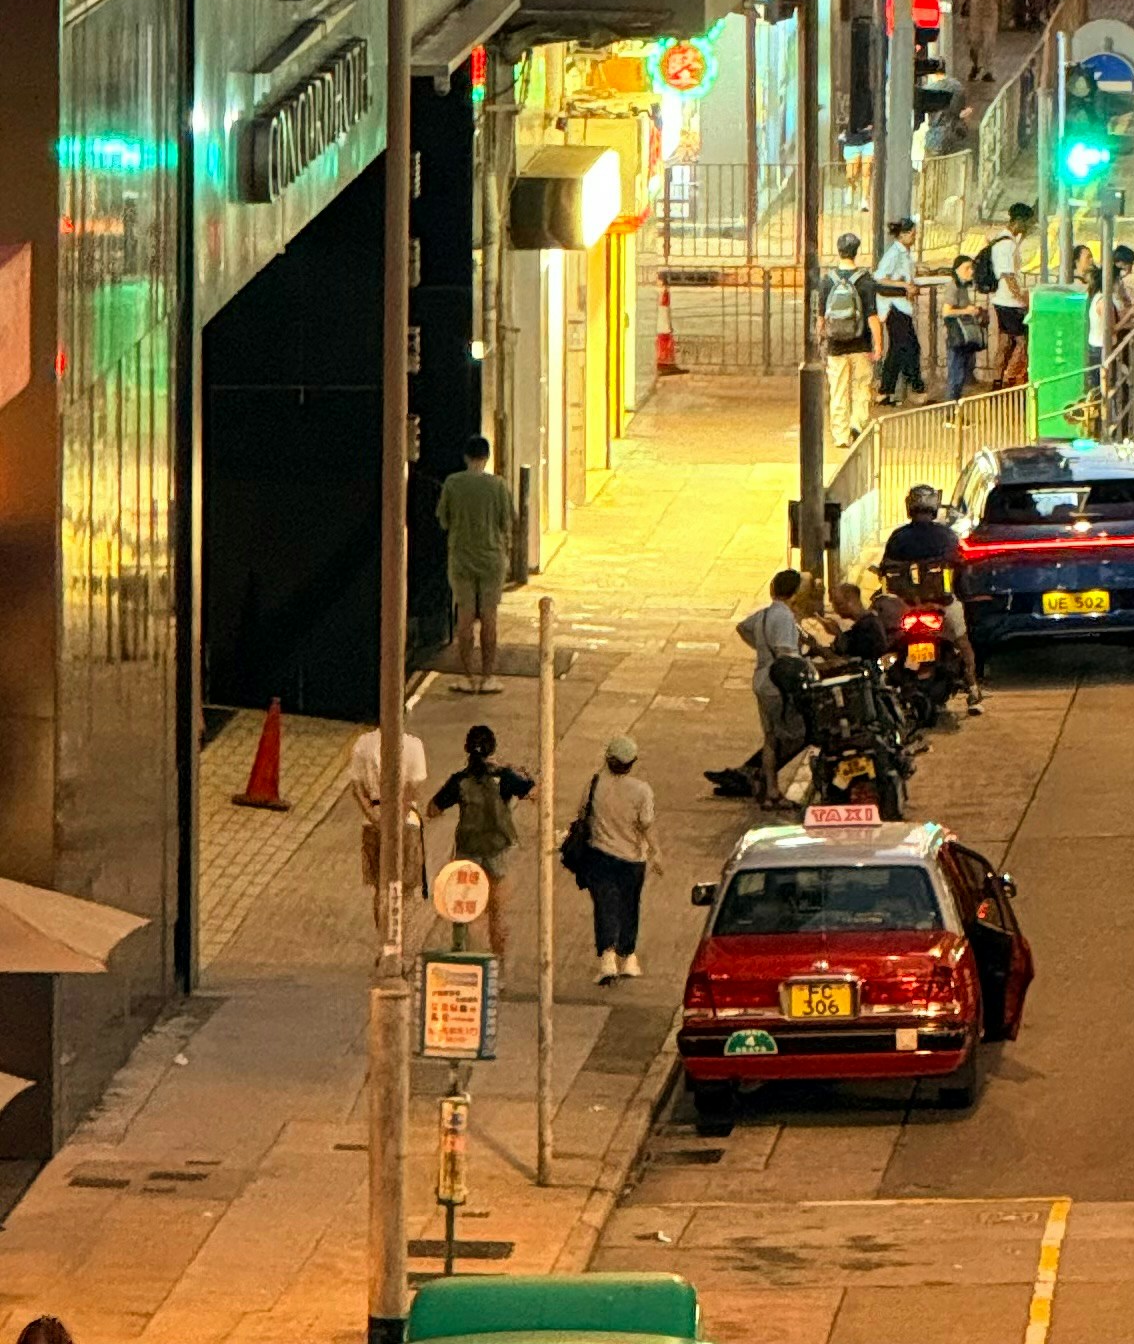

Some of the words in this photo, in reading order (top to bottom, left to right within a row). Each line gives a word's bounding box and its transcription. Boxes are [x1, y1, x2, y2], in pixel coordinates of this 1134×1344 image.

[1048, 596, 1068, 610] UE
[1074, 596, 1105, 609] 502
[811, 808, 873, 822] TAXI
[808, 984, 833, 1000] FC
[802, 1000, 840, 1015] 306
